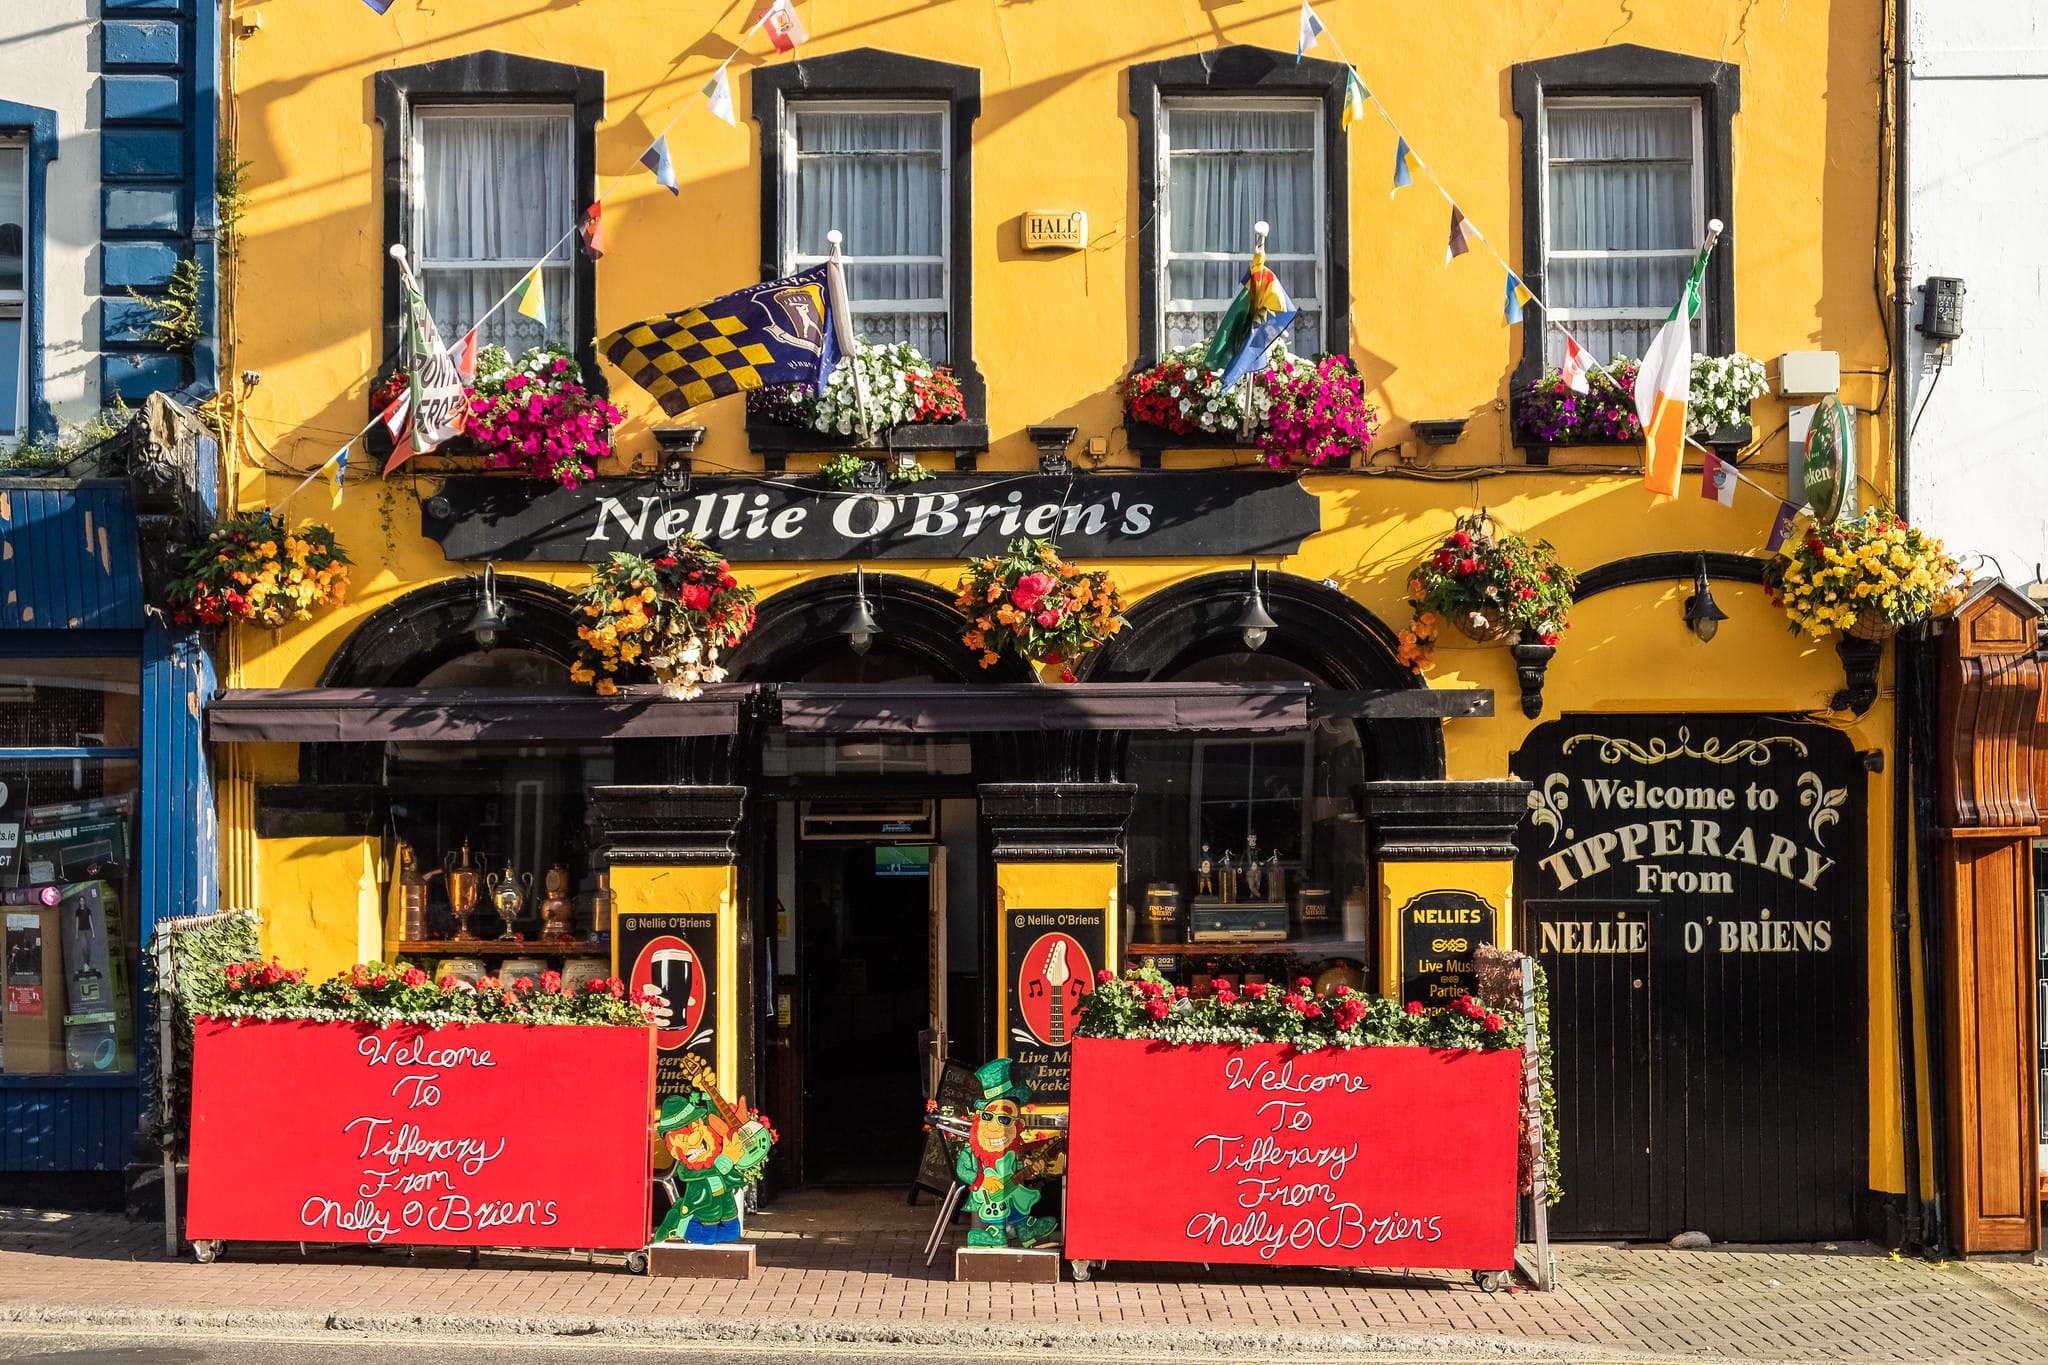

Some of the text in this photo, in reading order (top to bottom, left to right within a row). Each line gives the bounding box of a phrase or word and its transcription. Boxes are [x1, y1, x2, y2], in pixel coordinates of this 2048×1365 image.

[1031, 218, 1078, 233] HALL
[586, 491, 1154, 541] Nellie O'Brien's
[1582, 779, 1779, 811] Welcome to
[1538, 819, 1836, 892] TIPPERARY
[1636, 864, 1734, 894] From
[626, 917, 711, 931] @ Nellie O'Briens
[1015, 914, 1100, 928] @ Nellie O'Briens
[1413, 909, 1481, 924] NELLIES
[1540, 913, 1647, 954] NELLIE
[1419, 960, 1475, 973] Live Musi
[1430, 984, 1470, 997] Parties
[358, 1035, 497, 1068] Welcome
[1018, 1051, 1049, 1063] Live
[1225, 1057, 1371, 1093] Welcome
[391, 1073, 441, 1109] To
[1256, 1100, 1313, 1131] To
[358, 1168, 456, 1198] From
[1237, 1177, 1337, 1208] From
[301, 1196, 401, 1243] Nelly
[1186, 1211, 1288, 1259] Nelly
